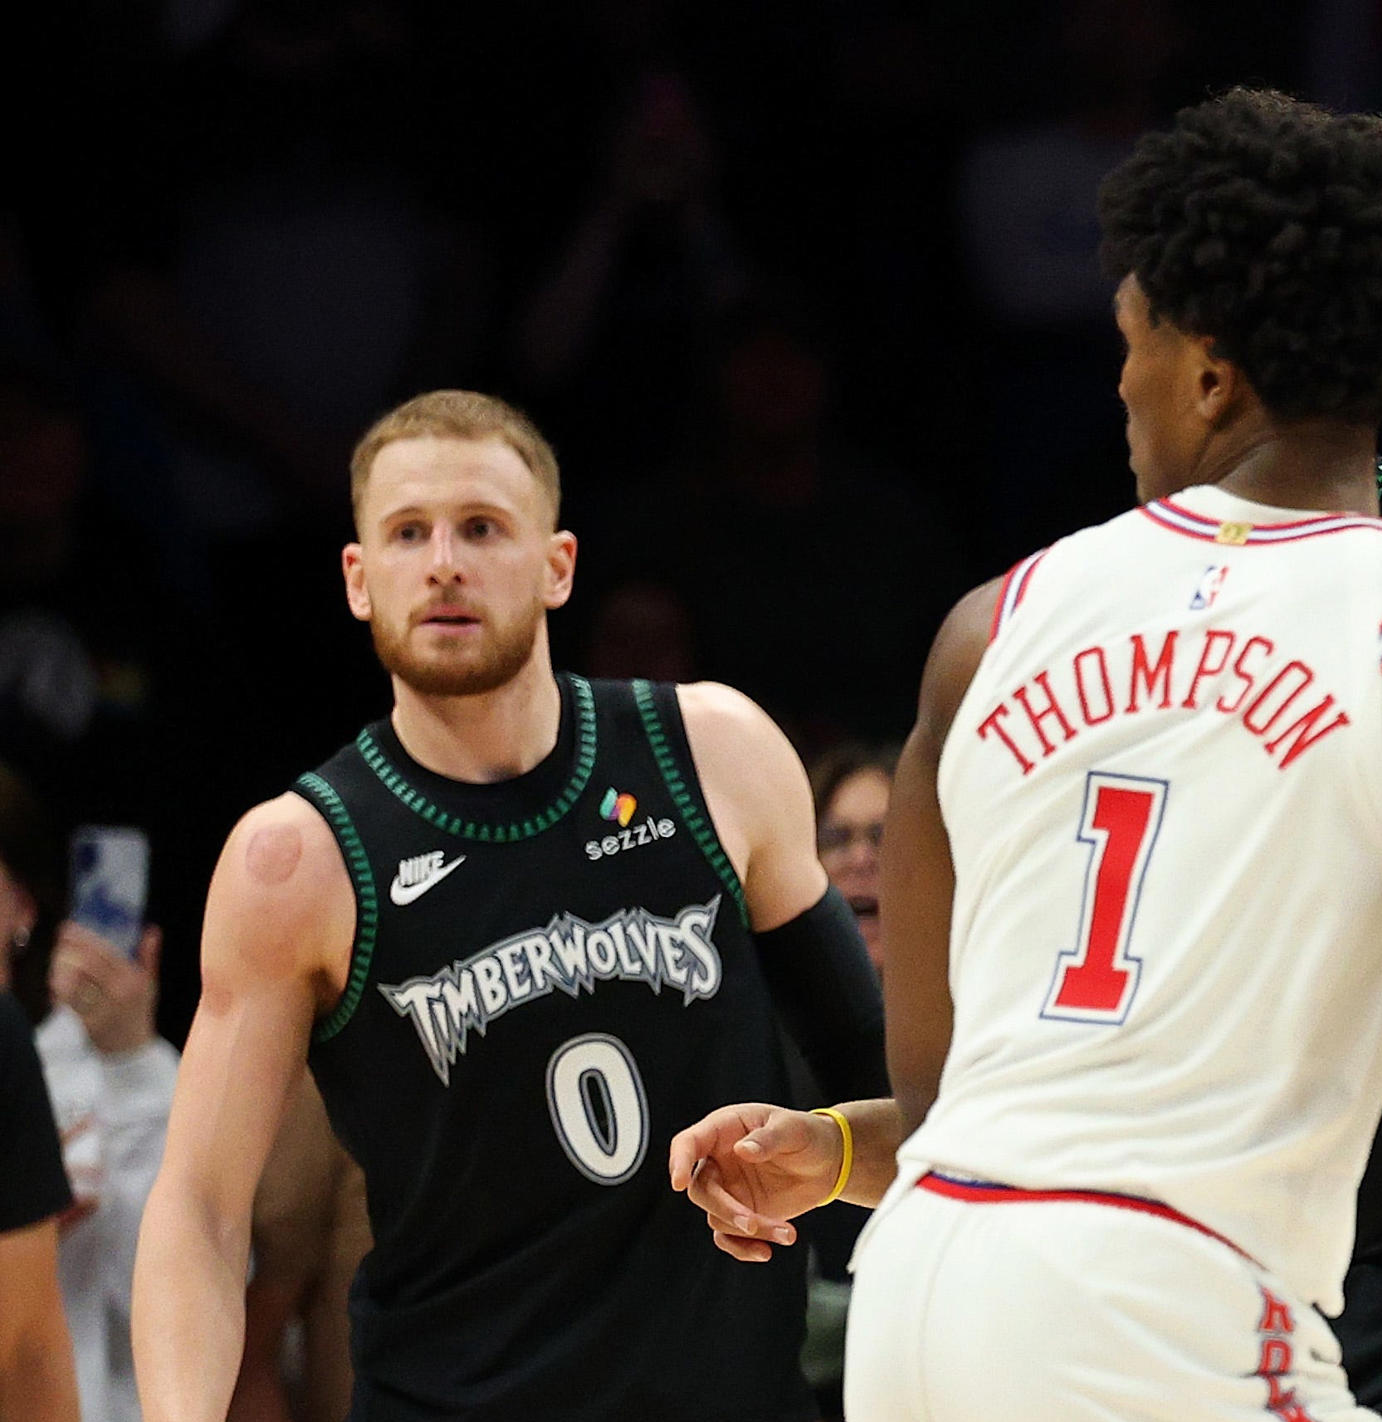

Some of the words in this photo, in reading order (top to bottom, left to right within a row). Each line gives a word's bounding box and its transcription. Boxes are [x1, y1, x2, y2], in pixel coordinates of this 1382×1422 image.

[977, 629, 1350, 775] THOMPSON
[399, 850, 445, 887] NIKE
[585, 816, 676, 860] sezzle
[1040, 771, 1170, 1026] 1
[378, 893, 722, 1087] TIMBERWOLVES
[545, 1033, 649, 1186] 0
